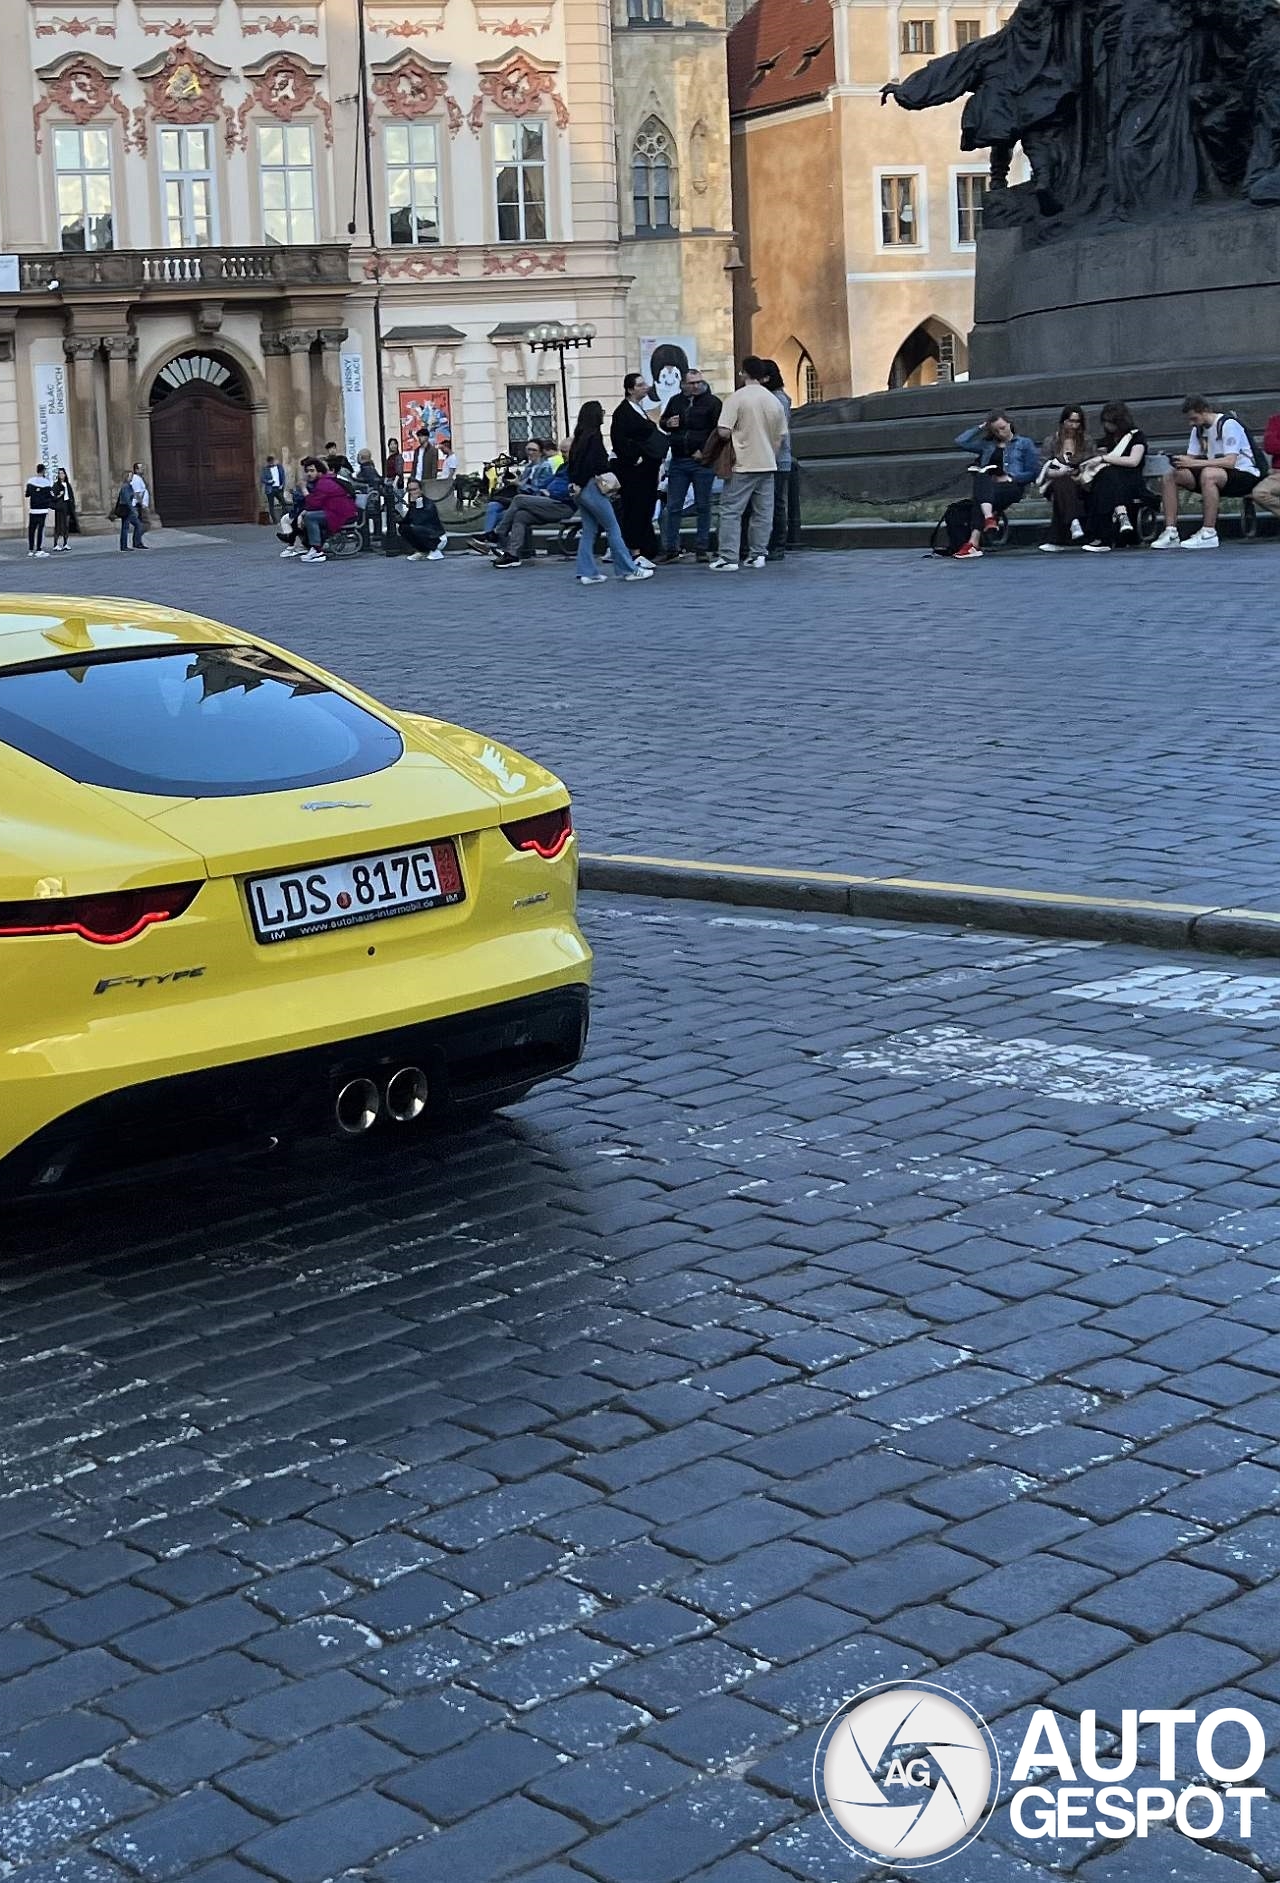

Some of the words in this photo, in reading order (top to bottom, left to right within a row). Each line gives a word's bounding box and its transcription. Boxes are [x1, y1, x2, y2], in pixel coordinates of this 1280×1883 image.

[256, 875, 332, 927] LDS
[352, 852, 437, 905] 817G
[93, 966, 207, 995] F-TYPE
